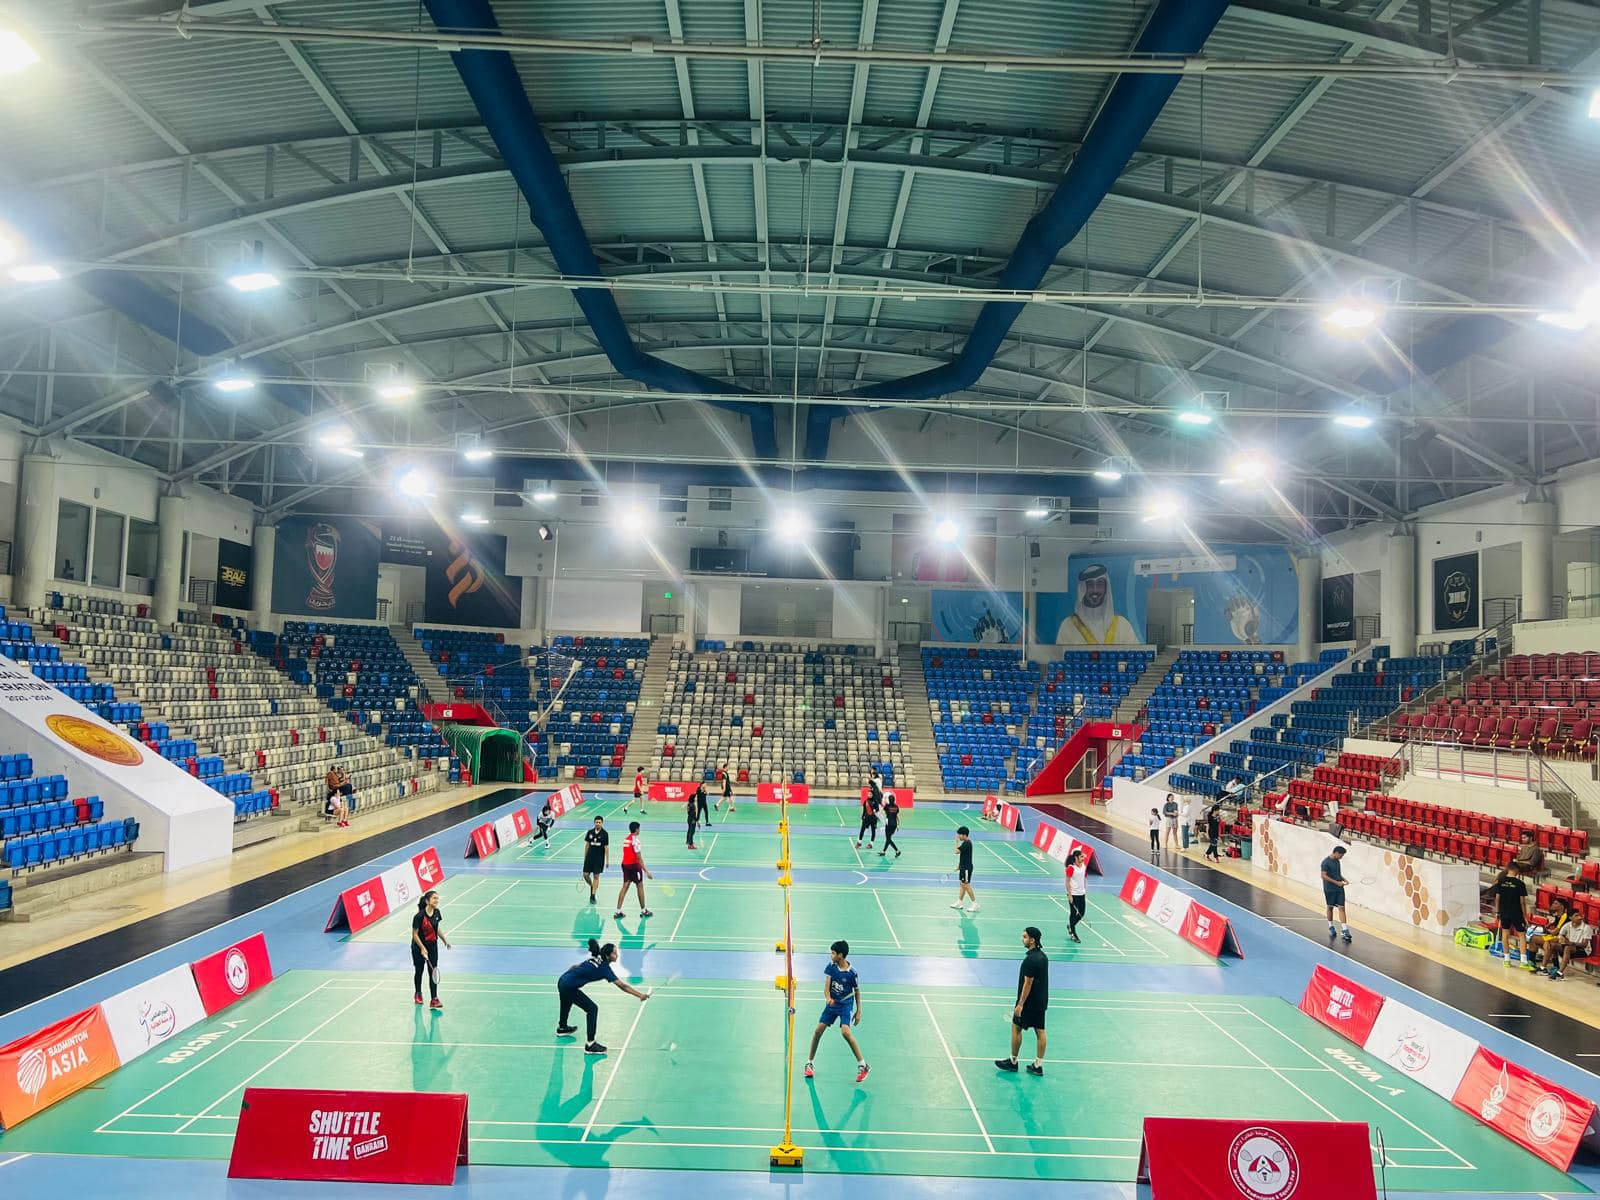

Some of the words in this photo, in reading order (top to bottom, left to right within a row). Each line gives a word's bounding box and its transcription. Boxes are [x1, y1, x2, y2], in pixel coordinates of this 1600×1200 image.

[47, 1030, 89, 1057] BADMINTON
[156, 1030, 230, 1064] VICTOR
[51, 1045, 89, 1080] ASIA
[1324, 1047, 1383, 1082] VICTOR
[309, 1110, 381, 1135] SHUTTLE
[312, 1136, 352, 1160] TIME
[356, 1139, 385, 1155] BAHRAIN
